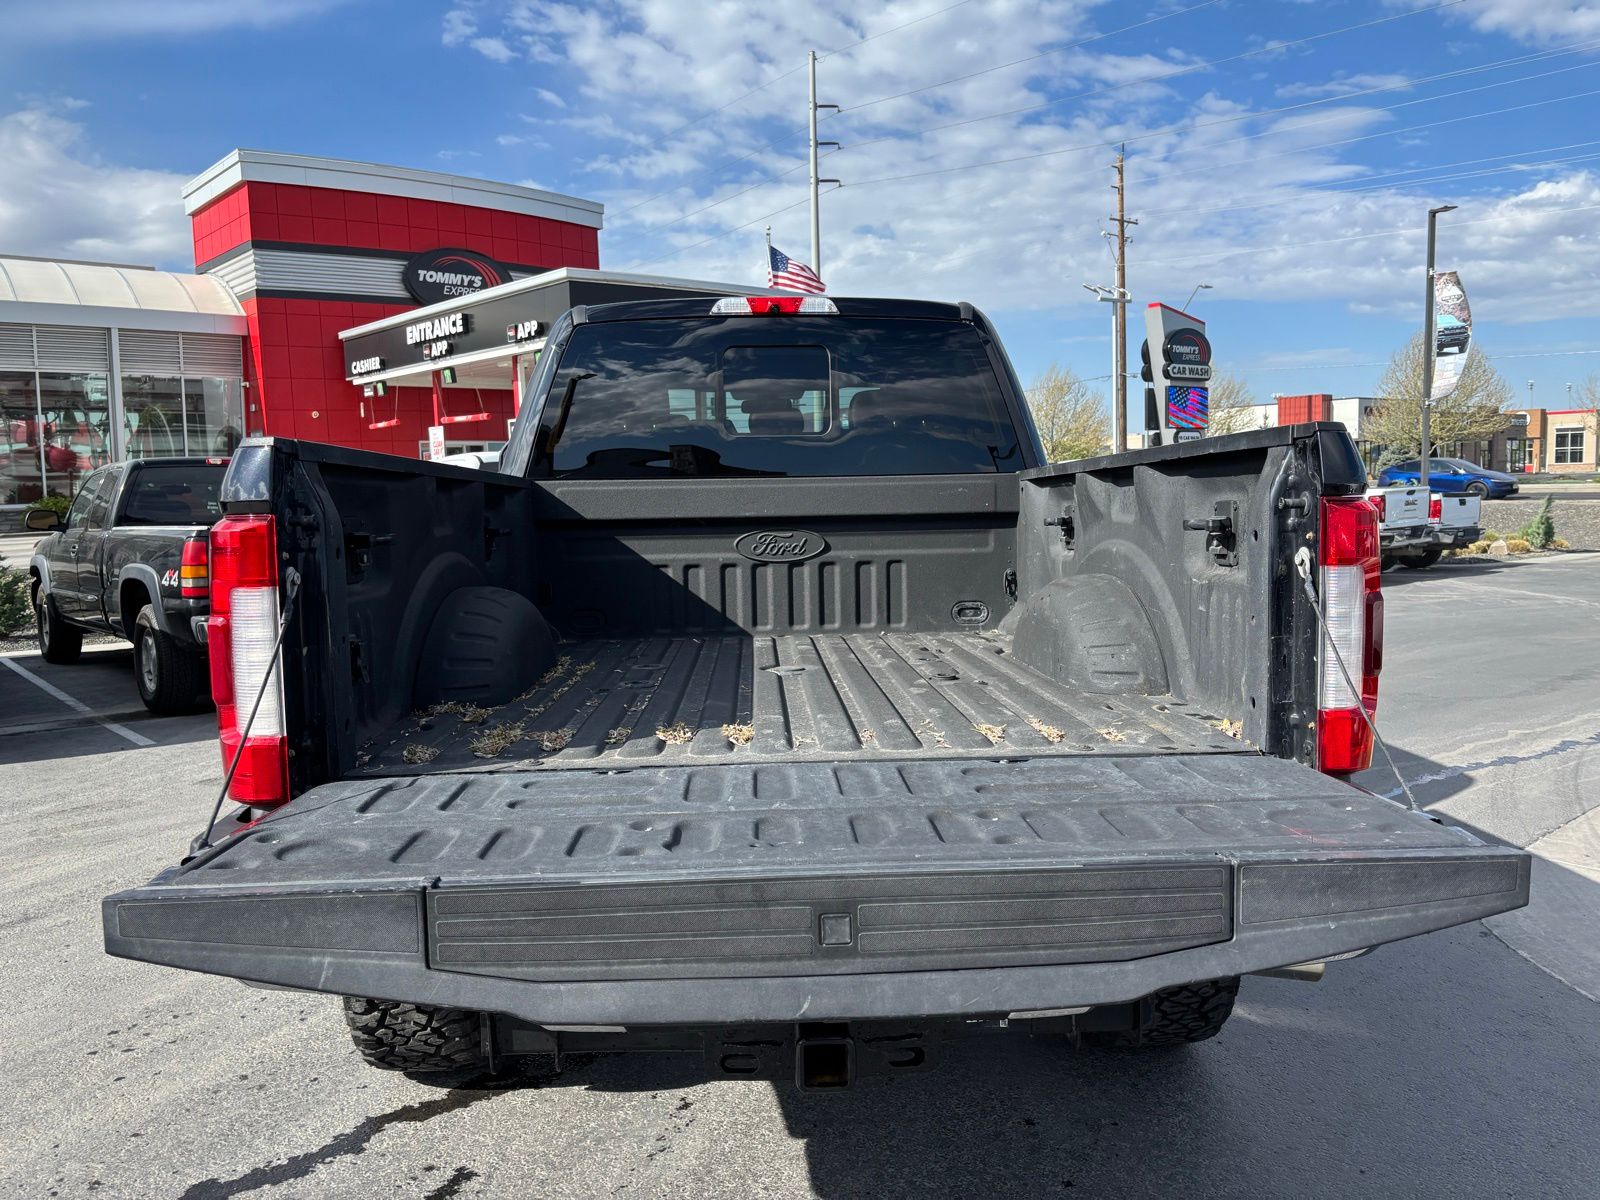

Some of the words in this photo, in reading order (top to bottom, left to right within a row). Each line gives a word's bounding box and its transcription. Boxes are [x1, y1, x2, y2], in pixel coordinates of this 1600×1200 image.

[418, 269, 483, 287] TOMMY'S
[406, 313, 463, 344] ENTRANCE
[517, 320, 538, 339] APP
[431, 341, 448, 357] APP
[1172, 345, 1199, 354] TOMMY'S
[351, 356, 381, 374] CASHIER
[1171, 366, 1186, 376] CAR
[1188, 366, 1209, 377] WASH
[751, 532, 807, 556] Ford
